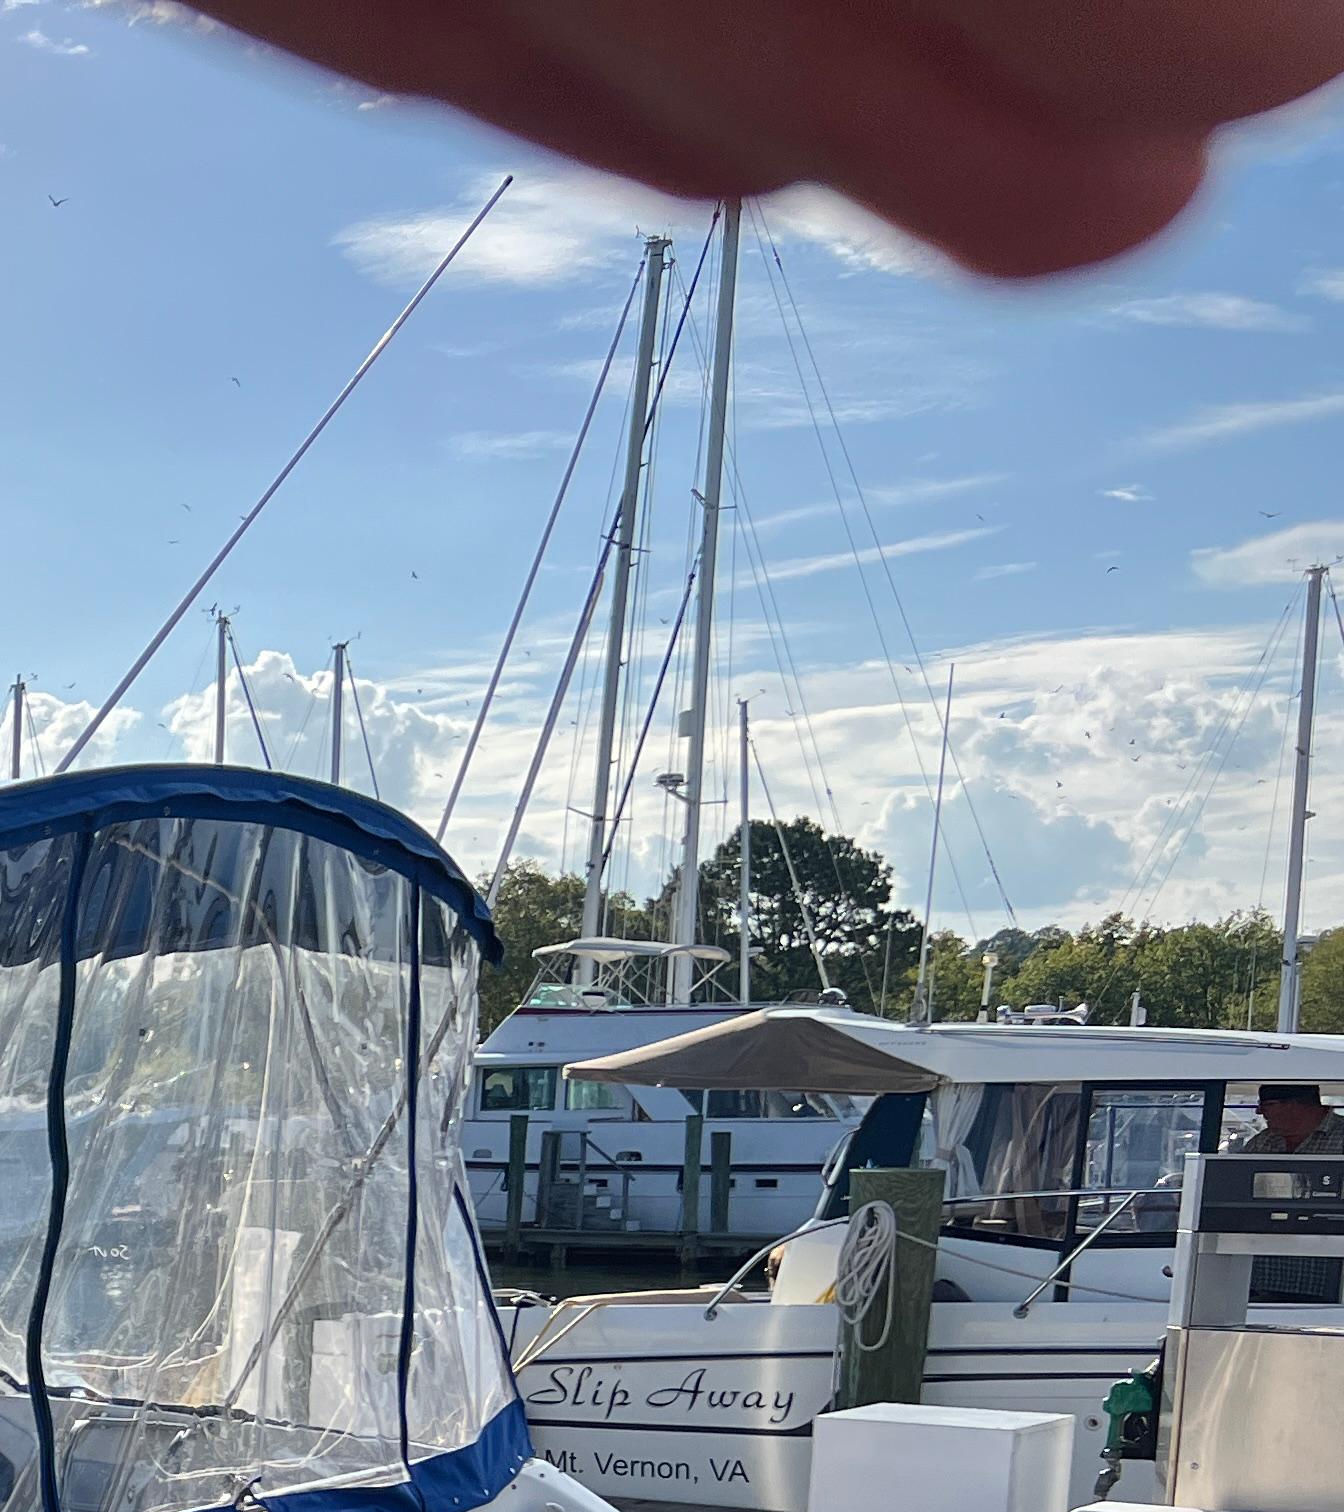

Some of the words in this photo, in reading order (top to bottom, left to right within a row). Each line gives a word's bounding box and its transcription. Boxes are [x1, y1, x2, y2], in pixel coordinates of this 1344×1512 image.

[526, 1366, 632, 1420] Slip
[646, 1368, 796, 1424] Away
[545, 1449, 584, 1474] Mt.
[594, 1452, 699, 1485] Vernon,
[710, 1458, 750, 1484] VA
